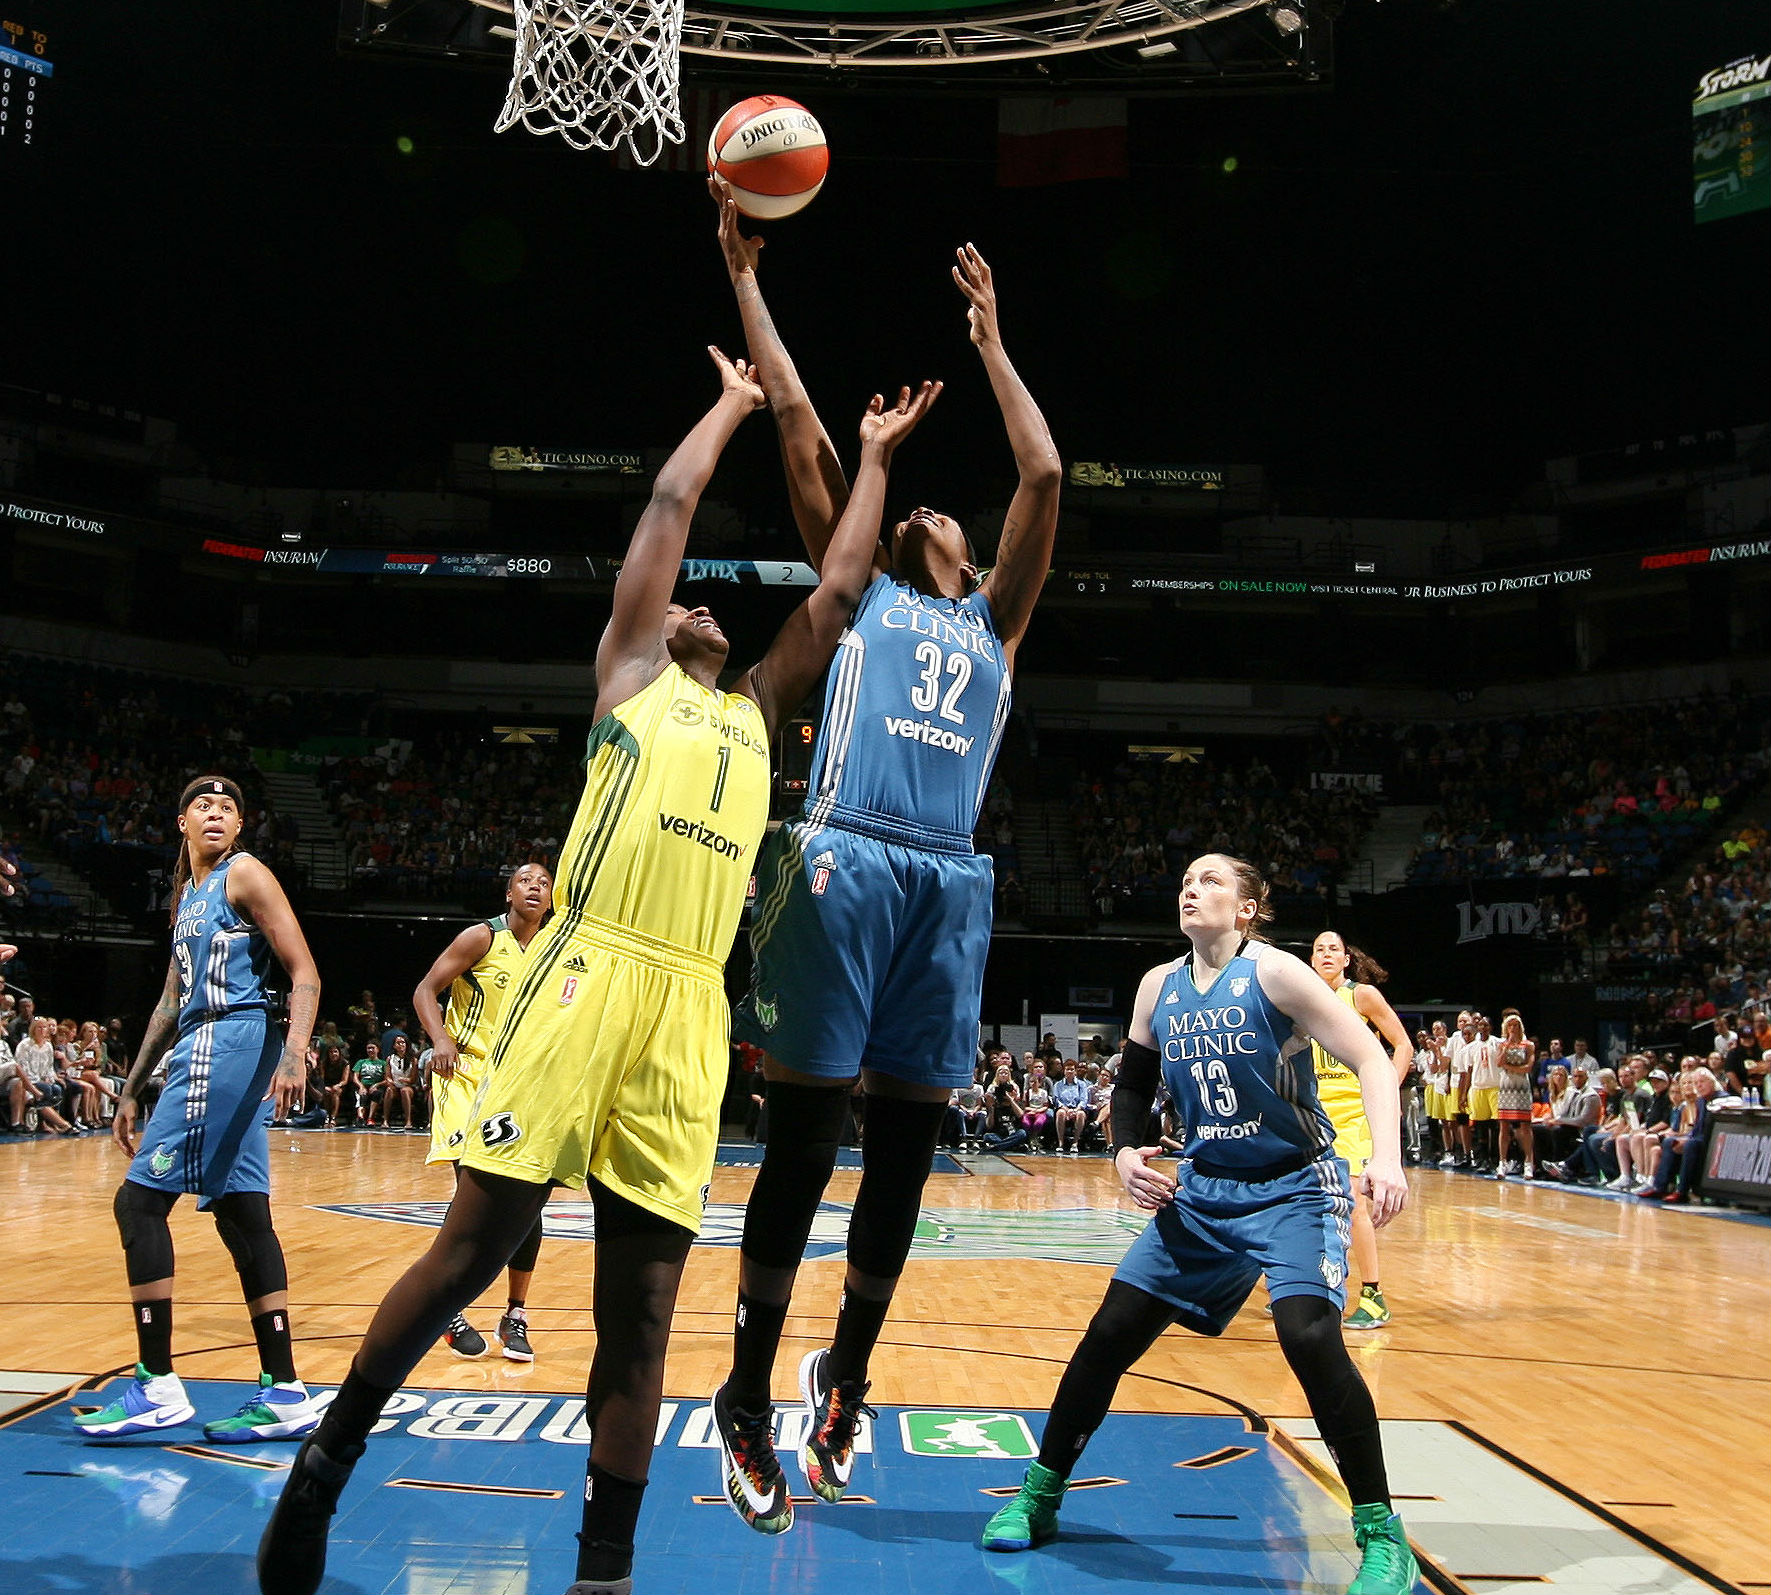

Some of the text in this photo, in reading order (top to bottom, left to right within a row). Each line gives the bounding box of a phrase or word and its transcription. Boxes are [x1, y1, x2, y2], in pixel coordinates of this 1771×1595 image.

[24, 60, 43, 74] PTS
[1694, 55, 1771, 101] STORM
[24, 134, 31, 144] 2
[507, 558, 551, 574] $880
[685, 559, 741, 584] LYNX
[781, 566, 794, 583] 2
[1077, 583, 1106, 593] 0 3
[1131, 579, 1150, 588] 2017
[1152, 580, 1214, 590] MEMBERSHIPS
[1219, 580, 1239, 591] ON
[1241, 581, 1273, 592] SALE
[1275, 581, 1307, 593] NOW
[881, 607, 996, 663] CLINIC
[910, 640, 974, 726] 32
[802, 725, 812, 744] 9
[884, 716, 972, 758] verizon
[710, 746, 732, 814] 1
[659, 812, 741, 863] verizon
[1456, 899, 1547, 944] LYNX
[1169, 1005, 1247, 1037] MAYO
[1164, 1031, 1258, 1062] CLINIC
[1190, 1059, 1240, 1118] 13
[1196, 1119, 1260, 1141] verizon
